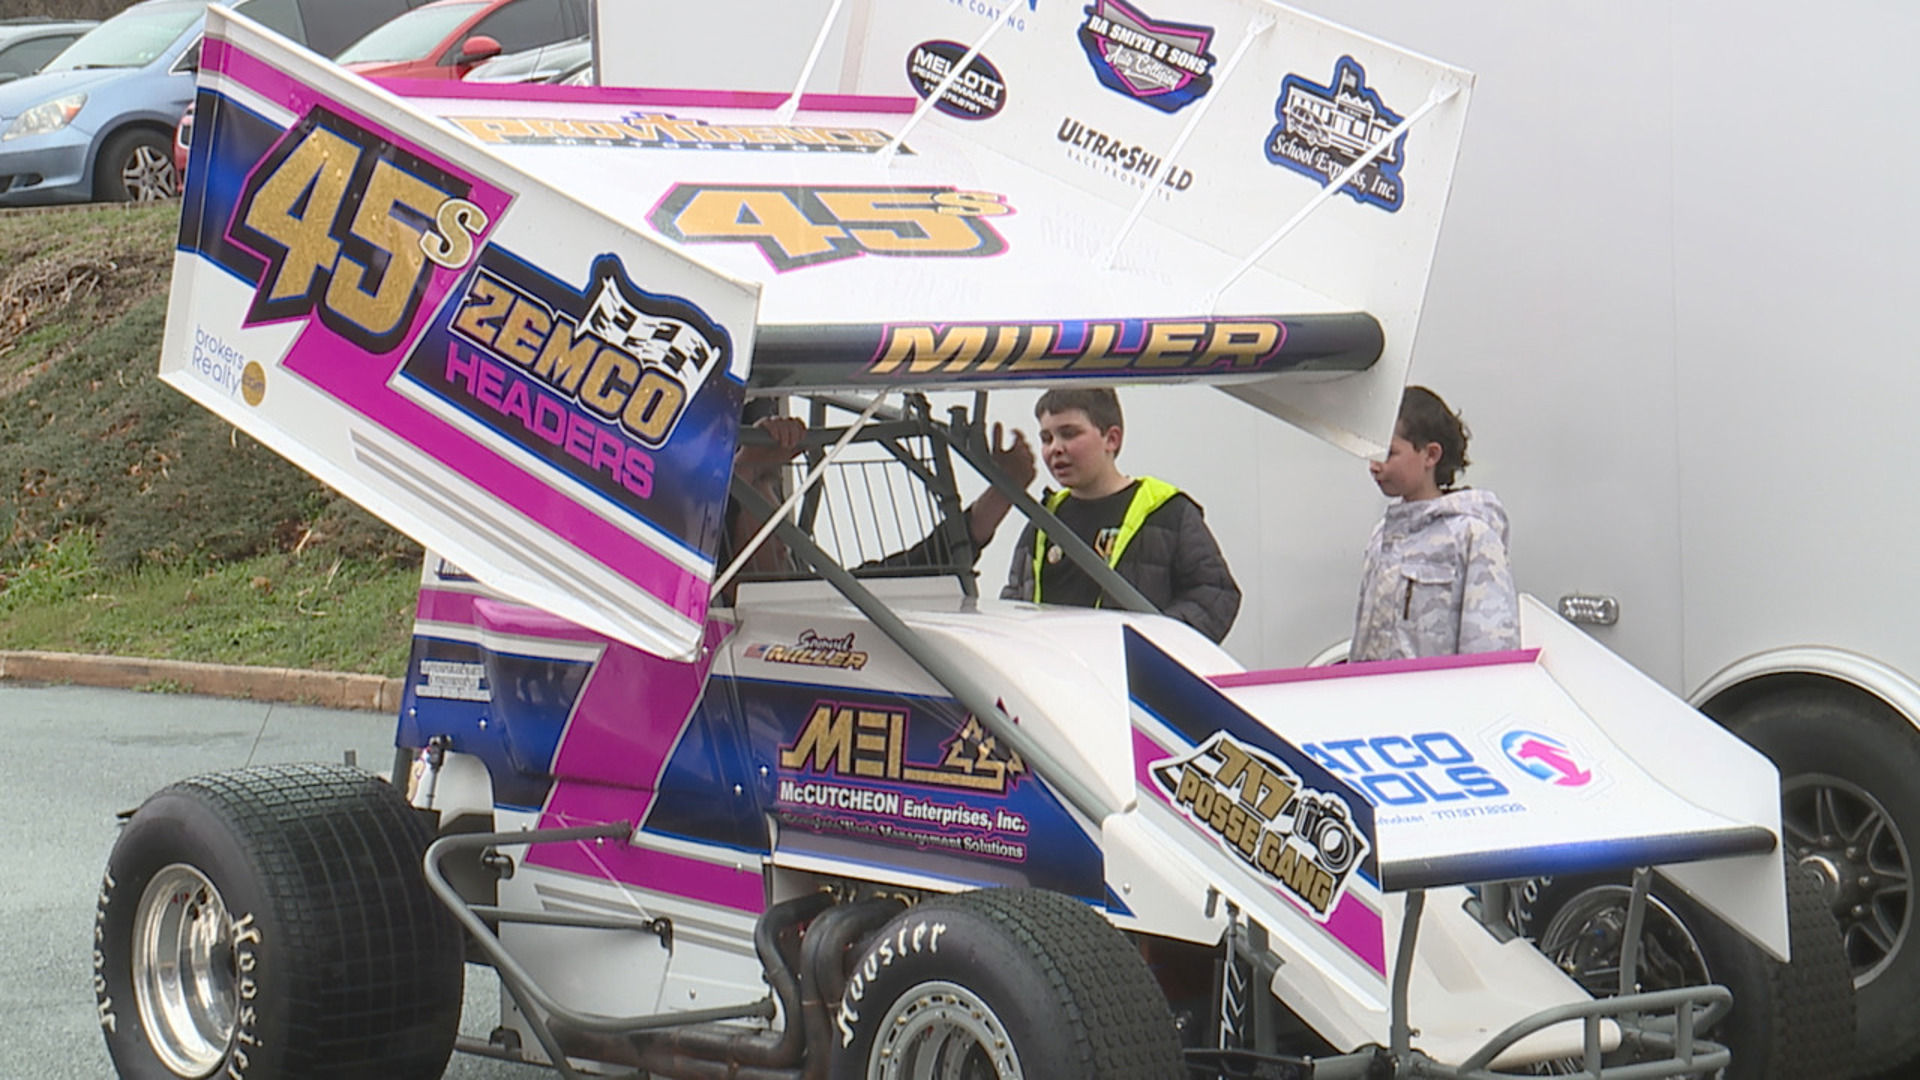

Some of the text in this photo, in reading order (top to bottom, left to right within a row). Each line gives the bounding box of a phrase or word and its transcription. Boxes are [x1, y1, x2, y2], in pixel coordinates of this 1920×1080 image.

[968, 0, 1025, 31] COATNG
[914, 47, 1004, 98] MELOTT
[1109, 23, 1156, 53] SMITH
[1154, 43, 1169, 60] &
[1168, 47, 1208, 74] SONS
[1272, 134, 1396, 201] School Expss, Inc.
[191, 345, 240, 396] Realty
[196, 323, 245, 371] brokers
[452, 276, 688, 441] ZEMCO
[870, 321, 1280, 374] MILLER
[445, 341, 656, 500] HEADERS
[765, 645, 868, 671] MILLER
[1301, 731, 1475, 775] ATCO
[1214, 738, 1295, 822] 717
[1346, 766, 1510, 807] OLS
[780, 781, 1027, 833] McCUTCHEON Enterprises, Inc.
[962, 836, 1024, 860] Solutions
[1177, 767, 1334, 915] POSSE GANG
[837, 919, 947, 1048] Hoosier
